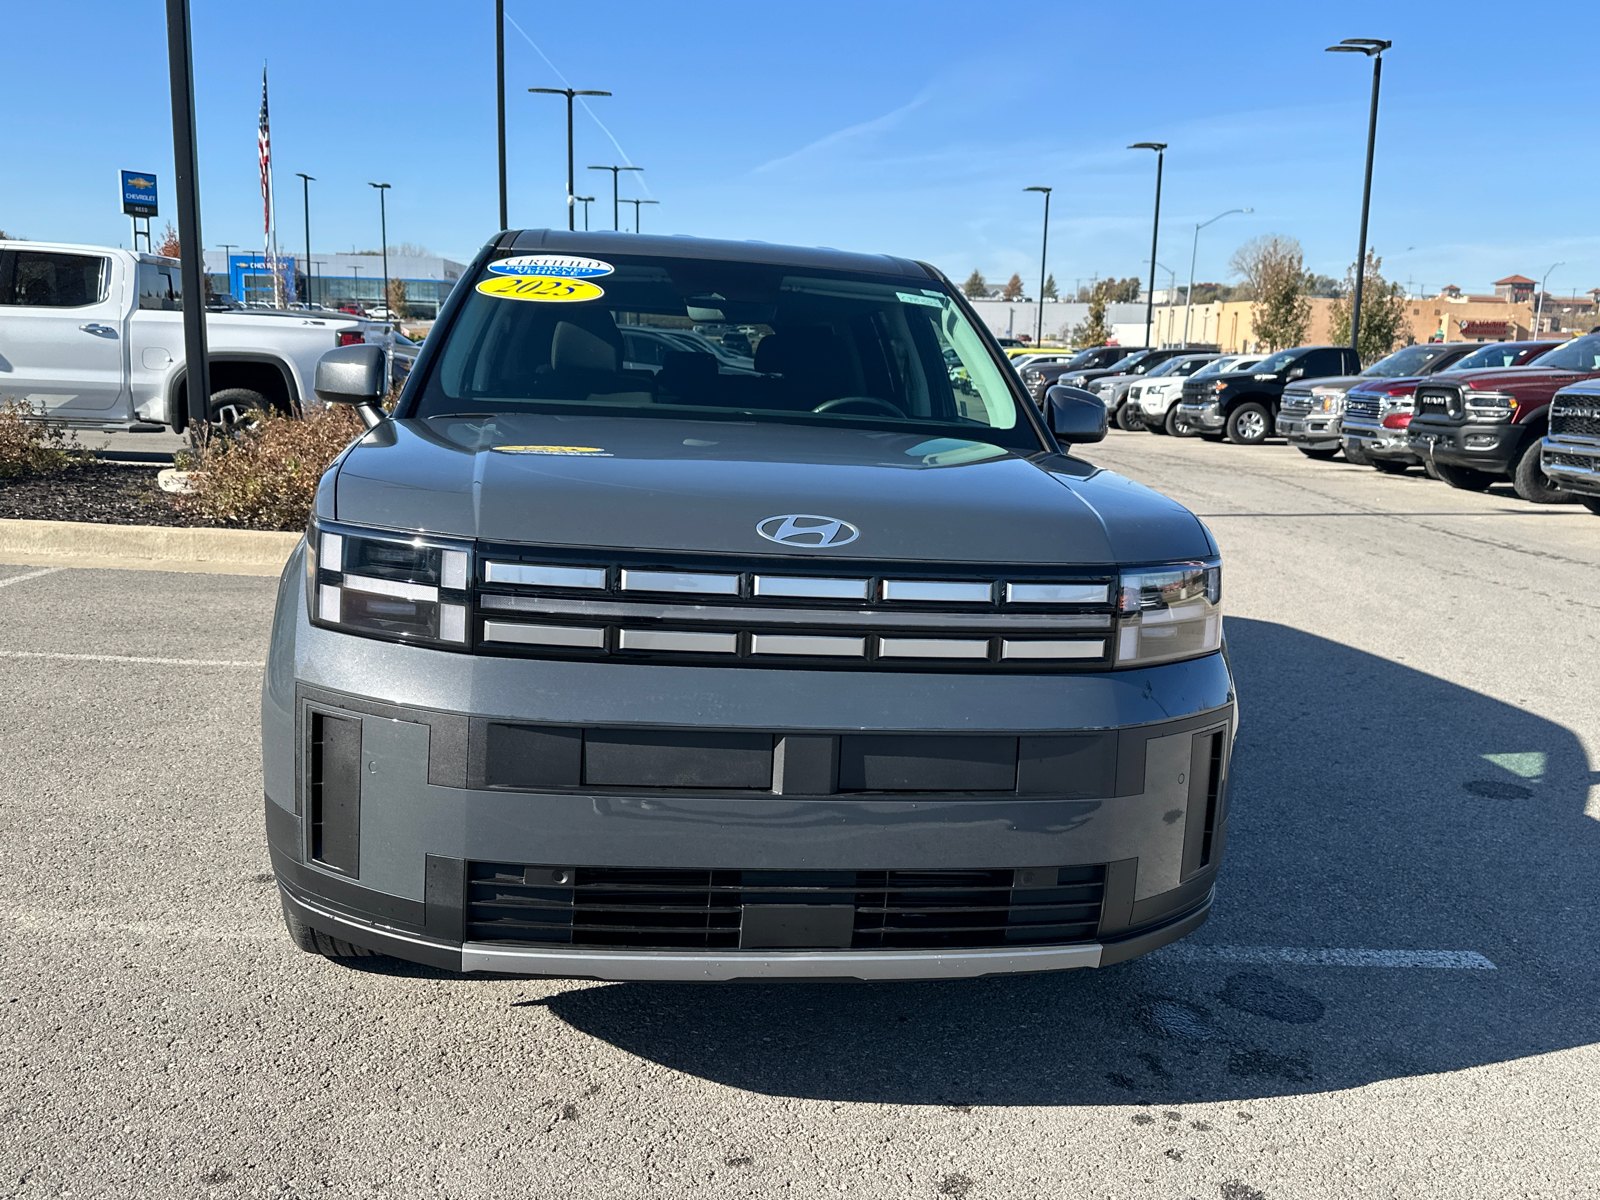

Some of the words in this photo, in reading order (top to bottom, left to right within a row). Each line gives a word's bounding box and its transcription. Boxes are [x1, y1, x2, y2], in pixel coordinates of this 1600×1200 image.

[126, 193, 155, 201] CHEVROLET
[505, 257, 601, 269] CERTIFIED
[505, 265, 593, 274] PRE-OWNED
[517, 269, 579, 277] VEHICLE
[493, 278, 584, 297] 2025
[1423, 396, 1444, 405] RAM
[1560, 406, 1592, 418] RAM
